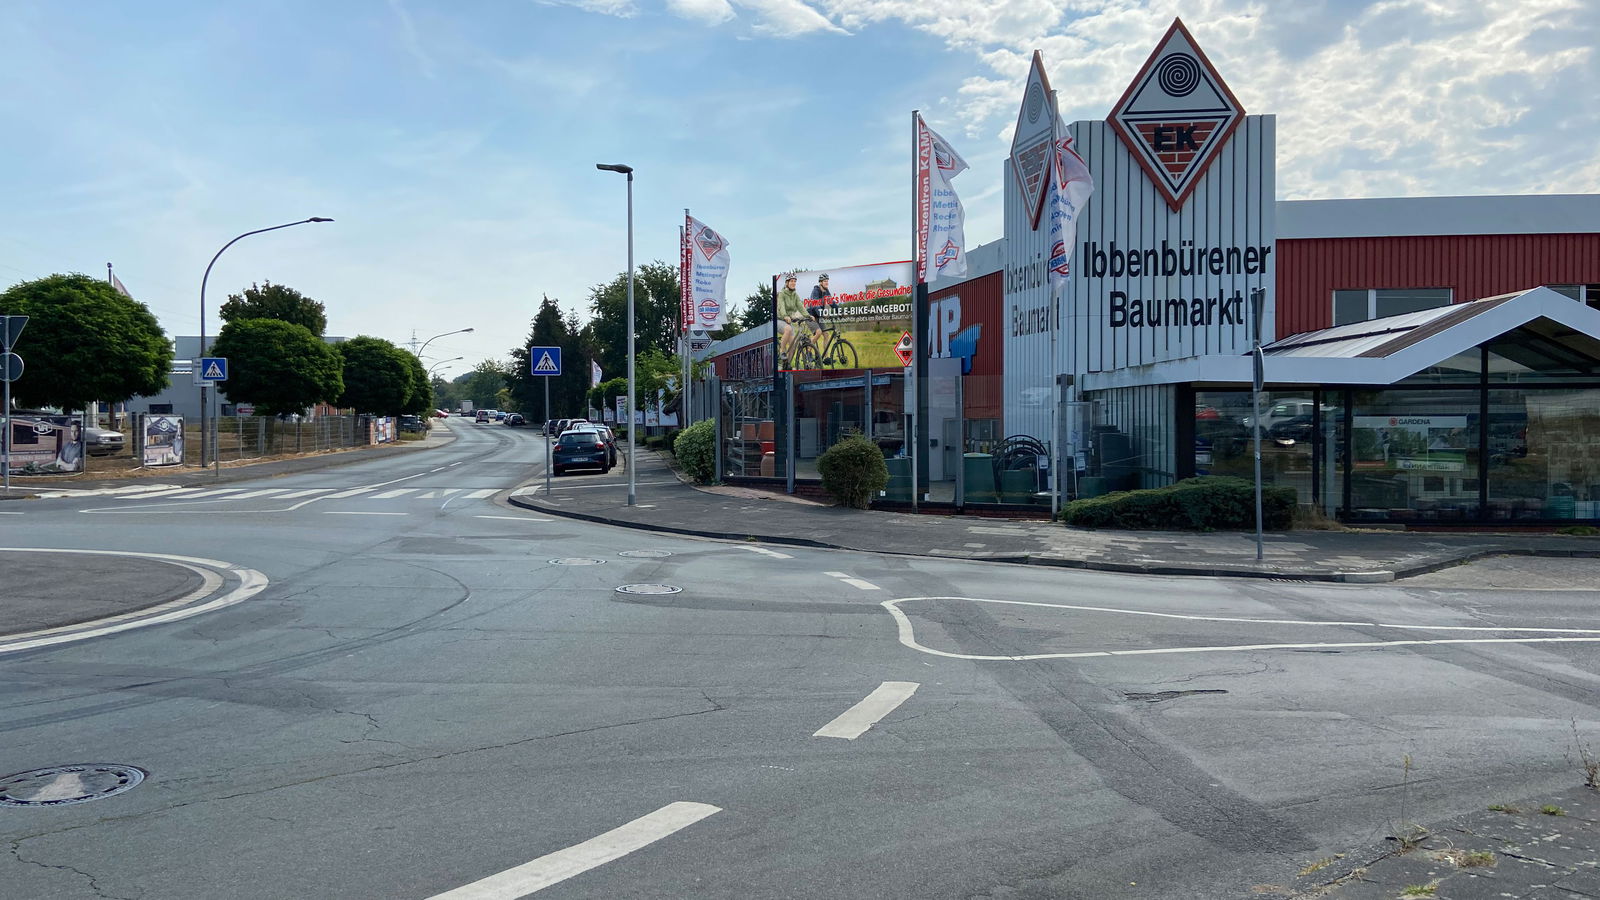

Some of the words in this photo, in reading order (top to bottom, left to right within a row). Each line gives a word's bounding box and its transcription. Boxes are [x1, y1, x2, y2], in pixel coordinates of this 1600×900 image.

[919, 123, 931, 169] KAM
[1153, 125, 1199, 152] EK
[919, 176, 930, 280] Baufachzentren
[1084, 240, 1271, 279] Ibbenbürener
[804, 297, 823, 309] Prima
[840, 293, 857, 303] Klima
[857, 291, 865, 301] &
[865, 290, 876, 300] die
[877, 284, 913, 298] Gesundhei
[819, 308, 842, 317] TOLLE
[1109, 289, 1244, 328] Baumarkt
[1012, 297, 1060, 338] Baumart
